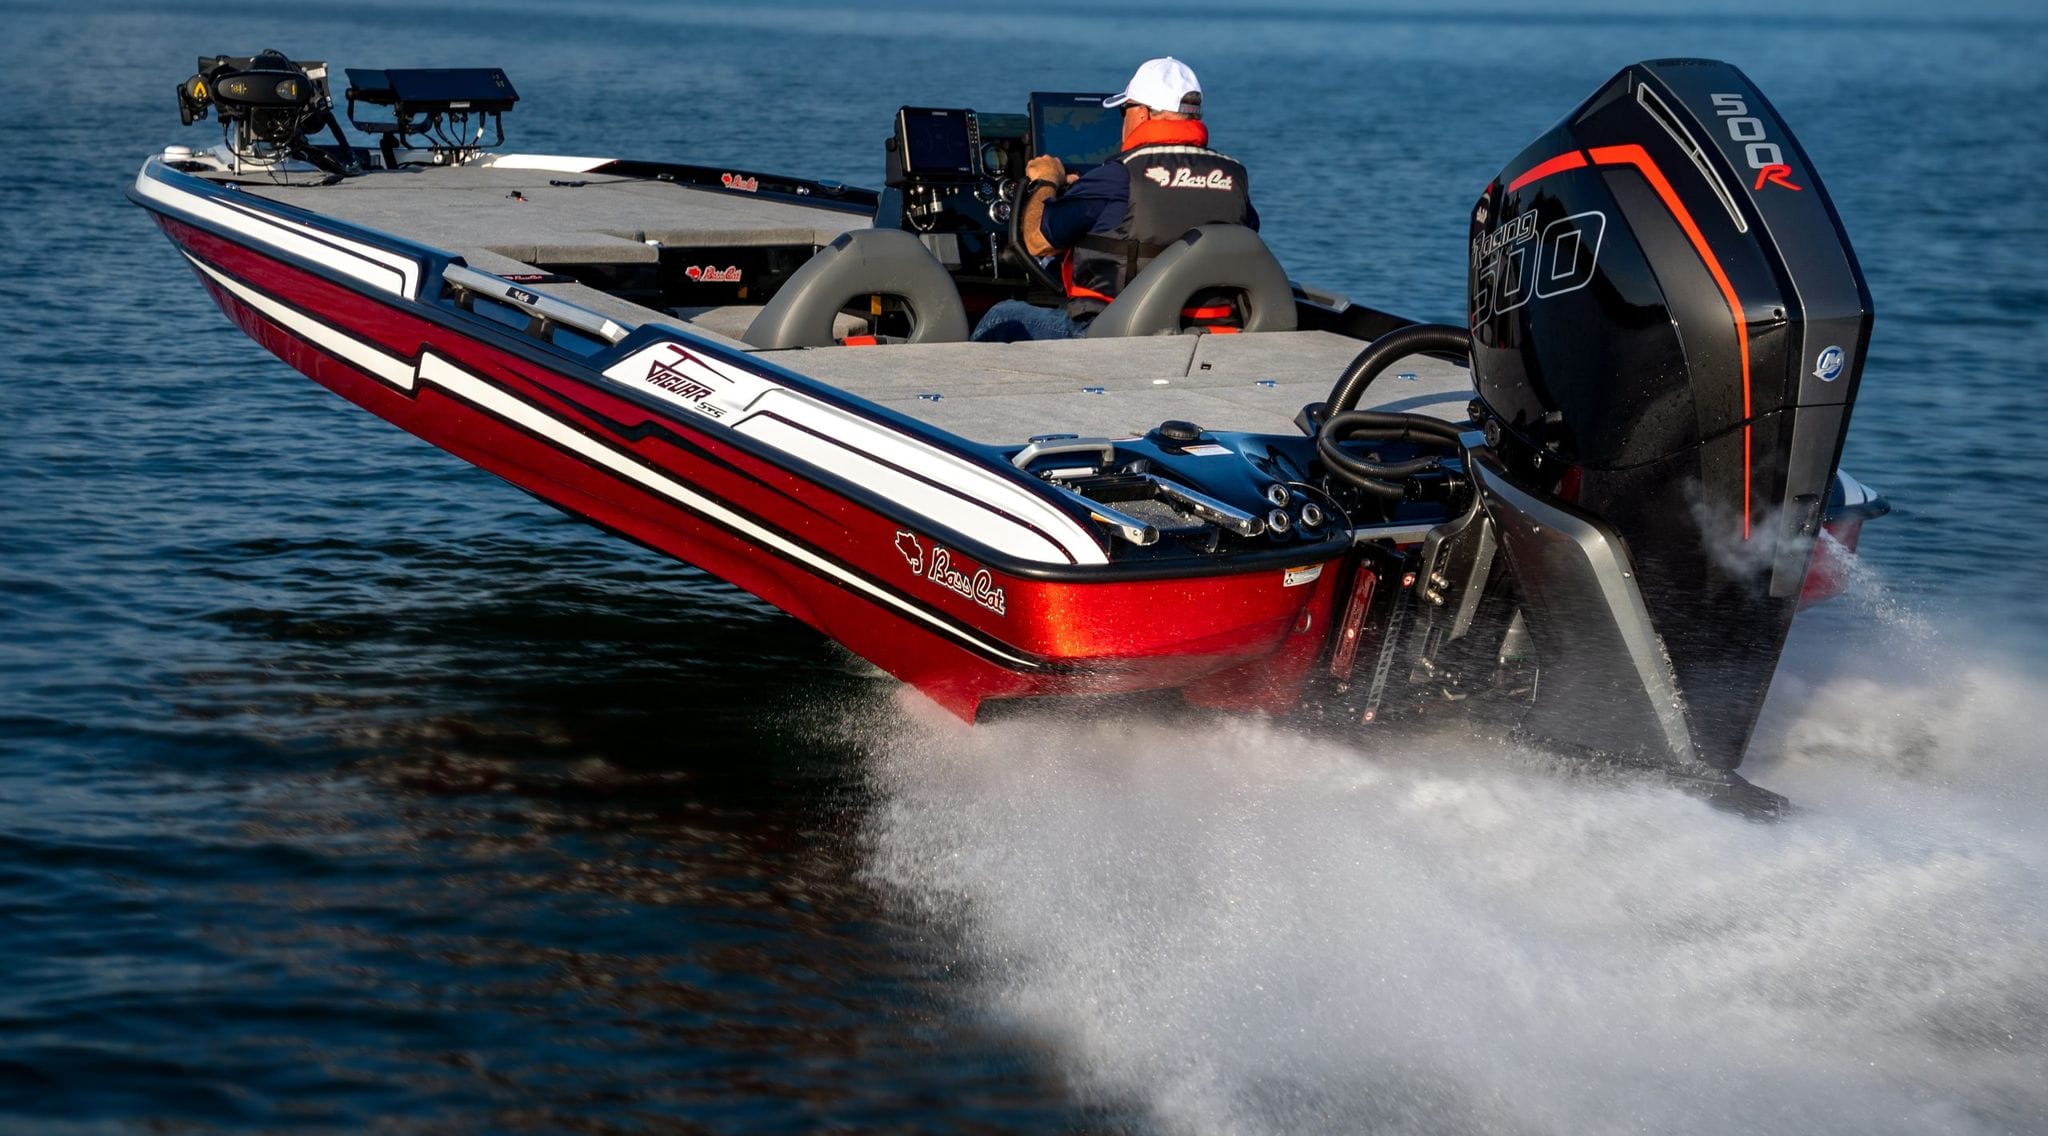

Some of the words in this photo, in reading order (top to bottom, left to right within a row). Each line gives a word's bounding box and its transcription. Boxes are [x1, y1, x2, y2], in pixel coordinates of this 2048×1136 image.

[1170, 167, 1206, 188] Bass
[1207, 169, 1233, 191] Cat
[1472, 208, 1538, 270] Racing
[1471, 210, 1607, 334] 500
[928, 547, 973, 598] Bass
[972, 569, 1005, 615] Cat
